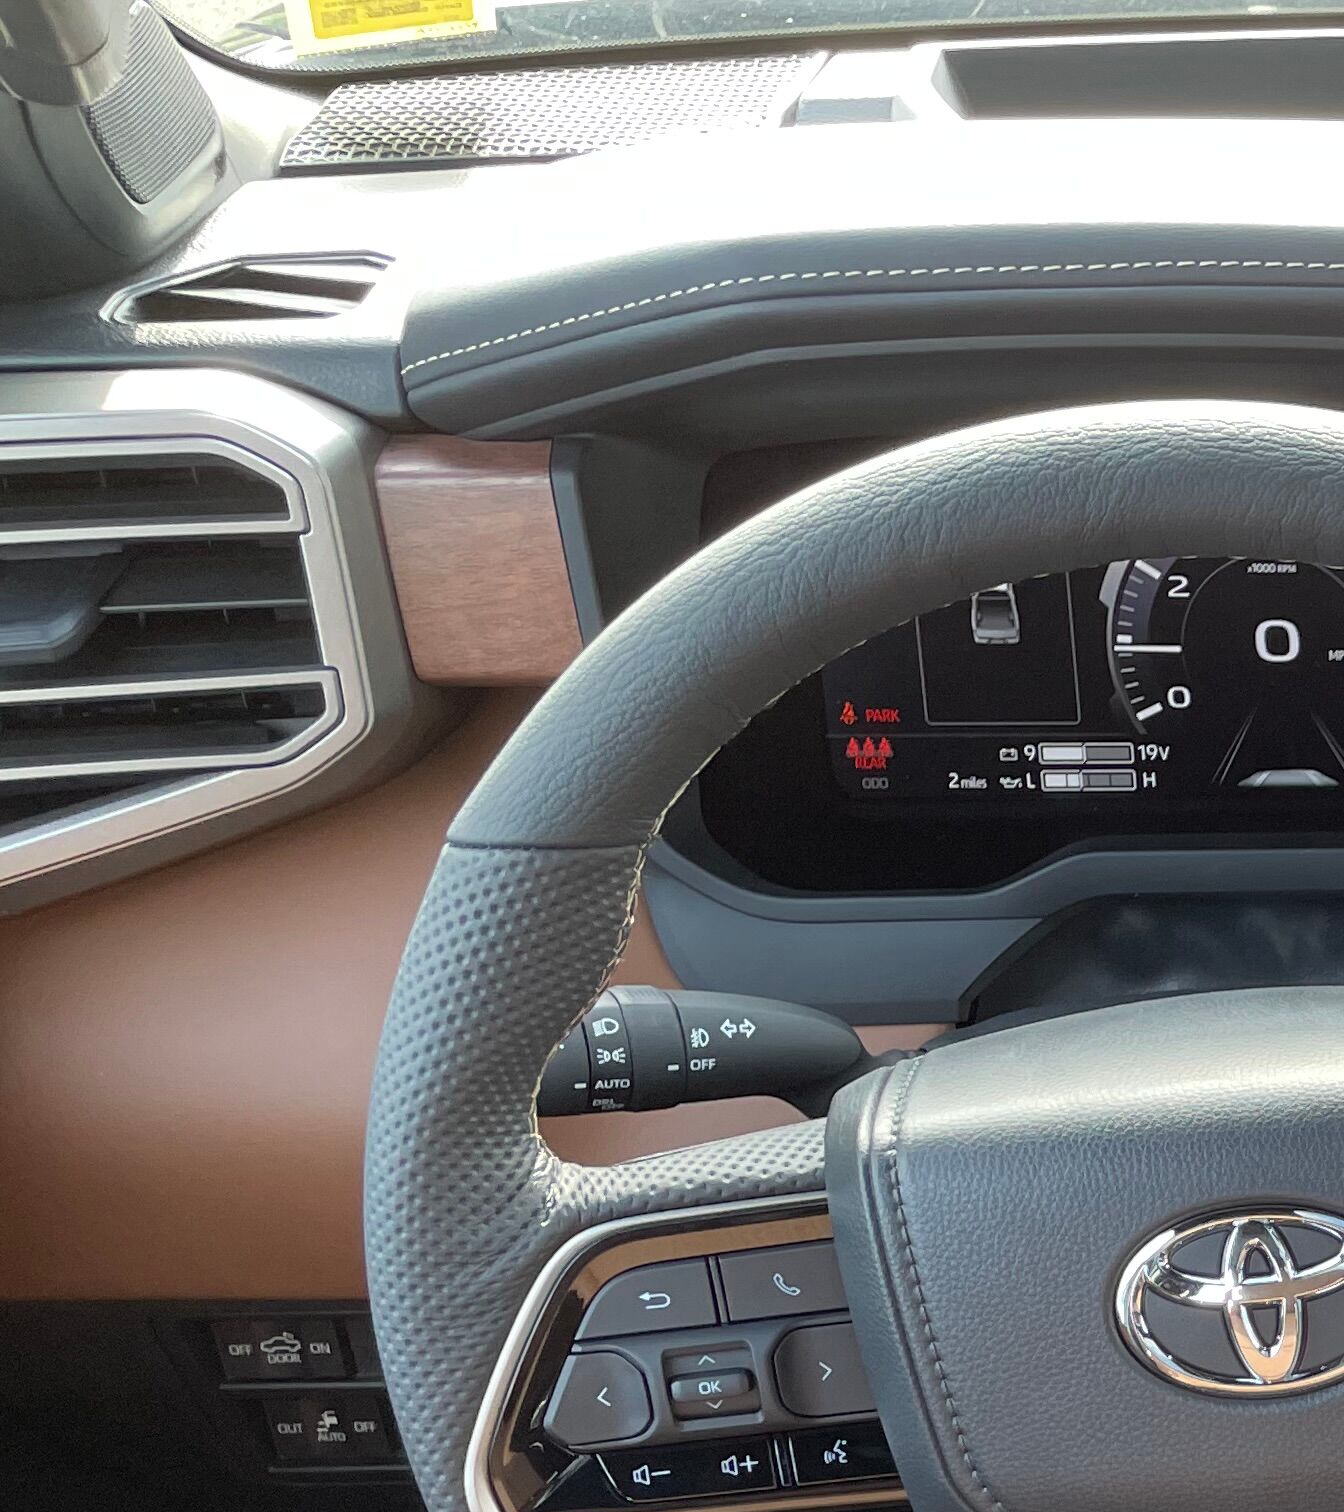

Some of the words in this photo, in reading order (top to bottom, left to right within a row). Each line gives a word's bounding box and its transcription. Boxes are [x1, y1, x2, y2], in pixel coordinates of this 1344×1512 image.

[1167, 575, 1191, 598] 2
[1254, 618, 1300, 662] 0
[1166, 686, 1191, 709] 0
[865, 708, 901, 723] PARK
[1023, 745, 1035, 761] 9
[1137, 745, 1170, 760] 19V
[862, 777, 889, 790] ODO
[1026, 772, 1036, 789] L
[1143, 774, 1157, 788] H
[690, 1058, 717, 1072] OFF
[594, 1078, 631, 1090] AUTO
[309, 1342, 331, 1354] ON
[698, 1380, 722, 1395] OK
[277, 1422, 303, 1434] OUT
[317, 1431, 347, 1442] AUTO
